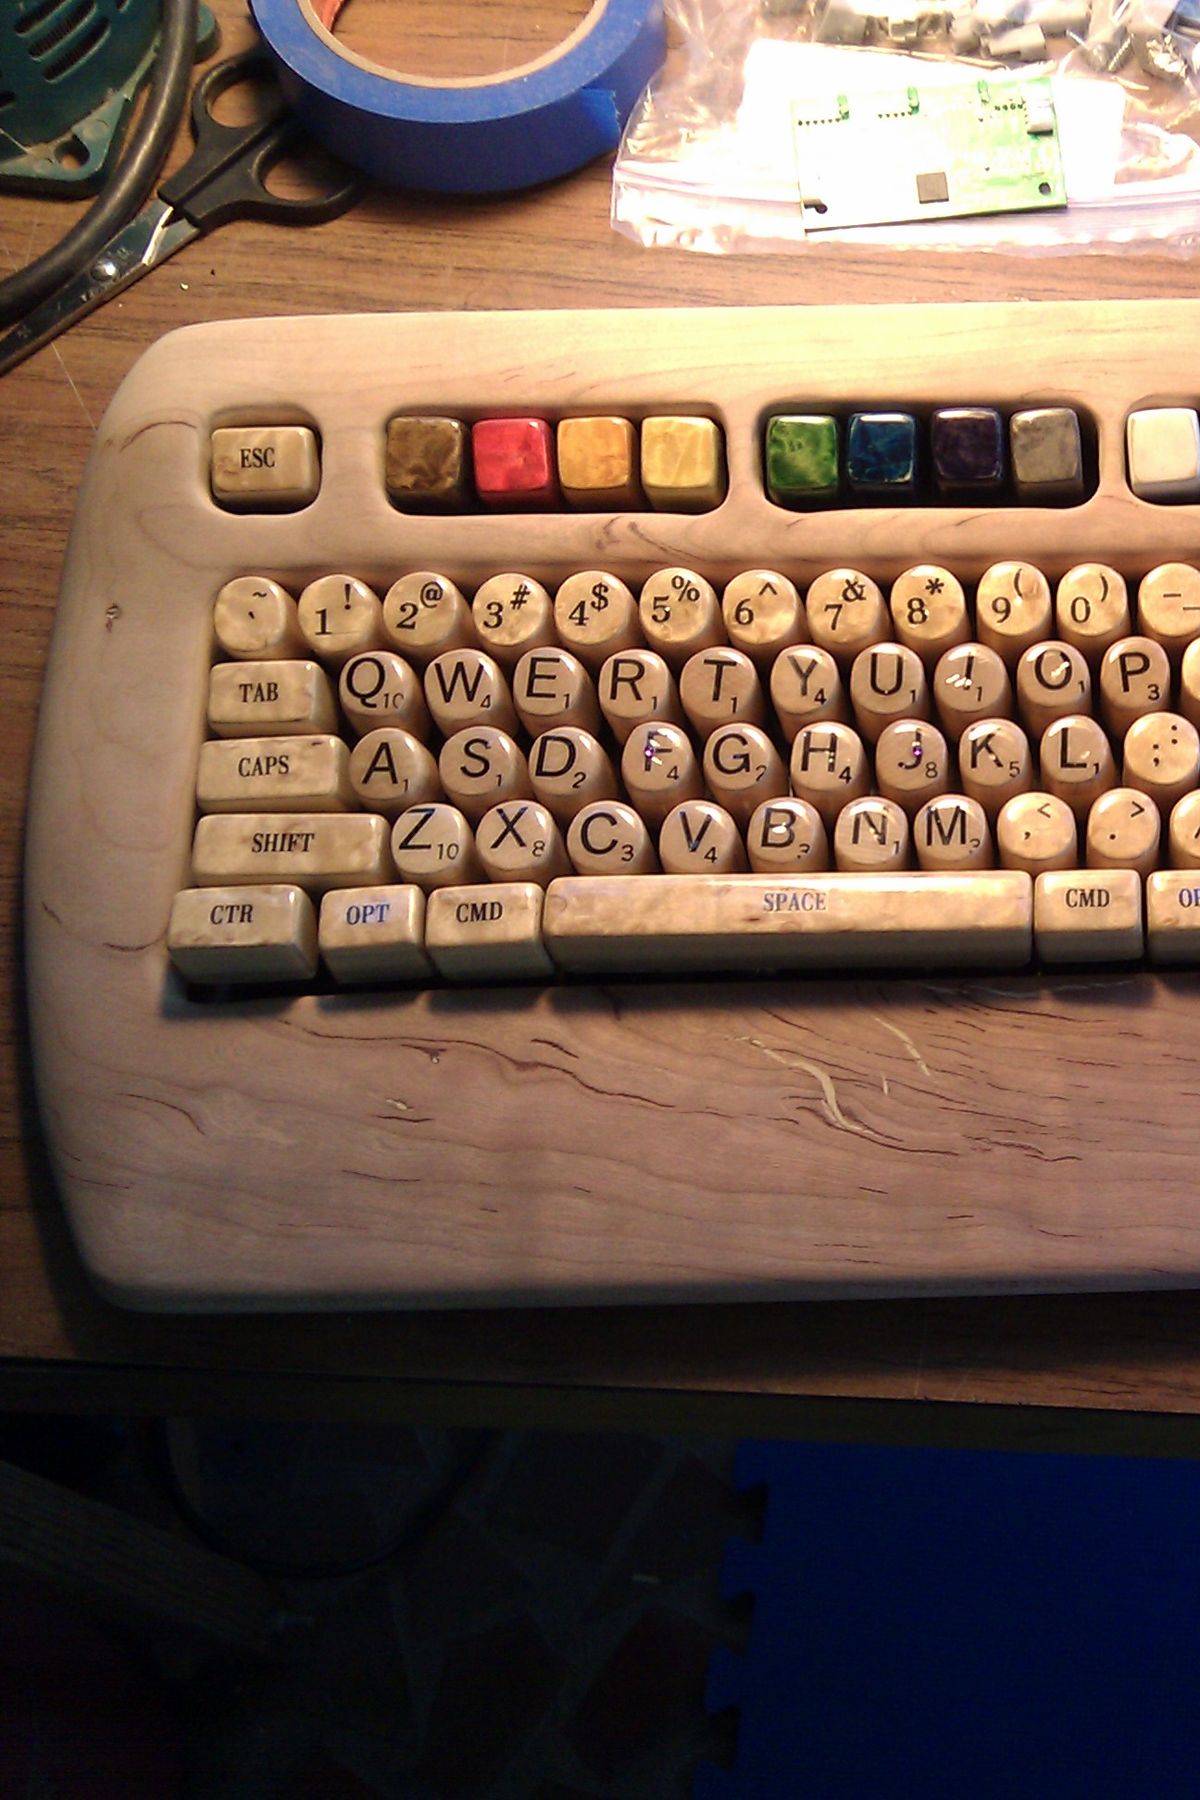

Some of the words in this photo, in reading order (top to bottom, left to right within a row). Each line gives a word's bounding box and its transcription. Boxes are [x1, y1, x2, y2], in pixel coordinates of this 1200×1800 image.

[240, 448, 275, 468] ESC
[315, 608, 333, 635] 1
[397, 603, 419, 629] 2
[484, 601, 503, 628] 3
[569, 600, 589, 626] 4
[652, 596, 671, 623] 5
[735, 598, 754, 625] 6
[824, 603, 842, 631] 7
[907, 598, 928, 624] 8
[991, 596, 1011, 623] 9
[1070, 596, 1091, 623] 0
[239, 682, 279, 702] TAB
[346, 657, 385, 708] Q
[384, 693, 404, 709] 10
[434, 661, 485, 703] W
[480, 695, 491, 709] 4
[526, 657, 560, 698] E
[563, 694, 570, 709] 1
[610, 658, 645, 701] R
[651, 696, 658, 710] 1
[703, 658, 737, 702] T
[731, 697, 738, 713] 1
[788, 654, 818, 696] Y
[814, 689, 827, 704] 4
[871, 652, 903, 695] U
[909, 690, 917, 703] 1
[1034, 650, 1072, 690] O
[1078, 680, 1085, 693] 1
[1119, 652, 1150, 692] P
[1147, 684, 1160, 701] 3
[977, 686, 983, 702] 1
[238, 755, 289, 777] CAPS
[361, 742, 398, 785] A
[403, 778, 409, 792] 1
[460, 738, 491, 778] S
[496, 774, 502, 786] 1
[535, 735, 576, 777] D
[572, 772, 586, 789] 2
[644, 731, 672, 771] F
[667, 766, 679, 780] 4
[712, 733, 750, 774] G
[756, 765, 767, 782] 2
[801, 731, 838, 772] H
[839, 767, 851, 784] 4
[898, 728, 922, 769] J
[925, 762, 937, 778] 8
[970, 728, 1004, 769] K
[1009, 761, 1020, 777] 5
[1060, 728, 1087, 768] L
[1093, 762, 1099, 774] 1
[251, 833, 314, 853] SHIFT
[398, 808, 436, 850] Z
[437, 843, 459, 860] 10
[490, 807, 528, 849] X
[532, 841, 545, 857] 8
[580, 812, 618, 854] C
[621, 844, 634, 862] 3
[679, 811, 712, 852] V
[704, 847, 717, 863] 4
[761, 807, 797, 848] B
[852, 807, 888, 845] N
[893, 841, 900, 855] 1
[926, 806, 967, 846] M
[210, 904, 253, 925] CTR
[347, 904, 390, 925] OPT
[456, 902, 503, 923] CMD
[763, 892, 827, 912] SPACE
[1065, 888, 1110, 908] CMD
